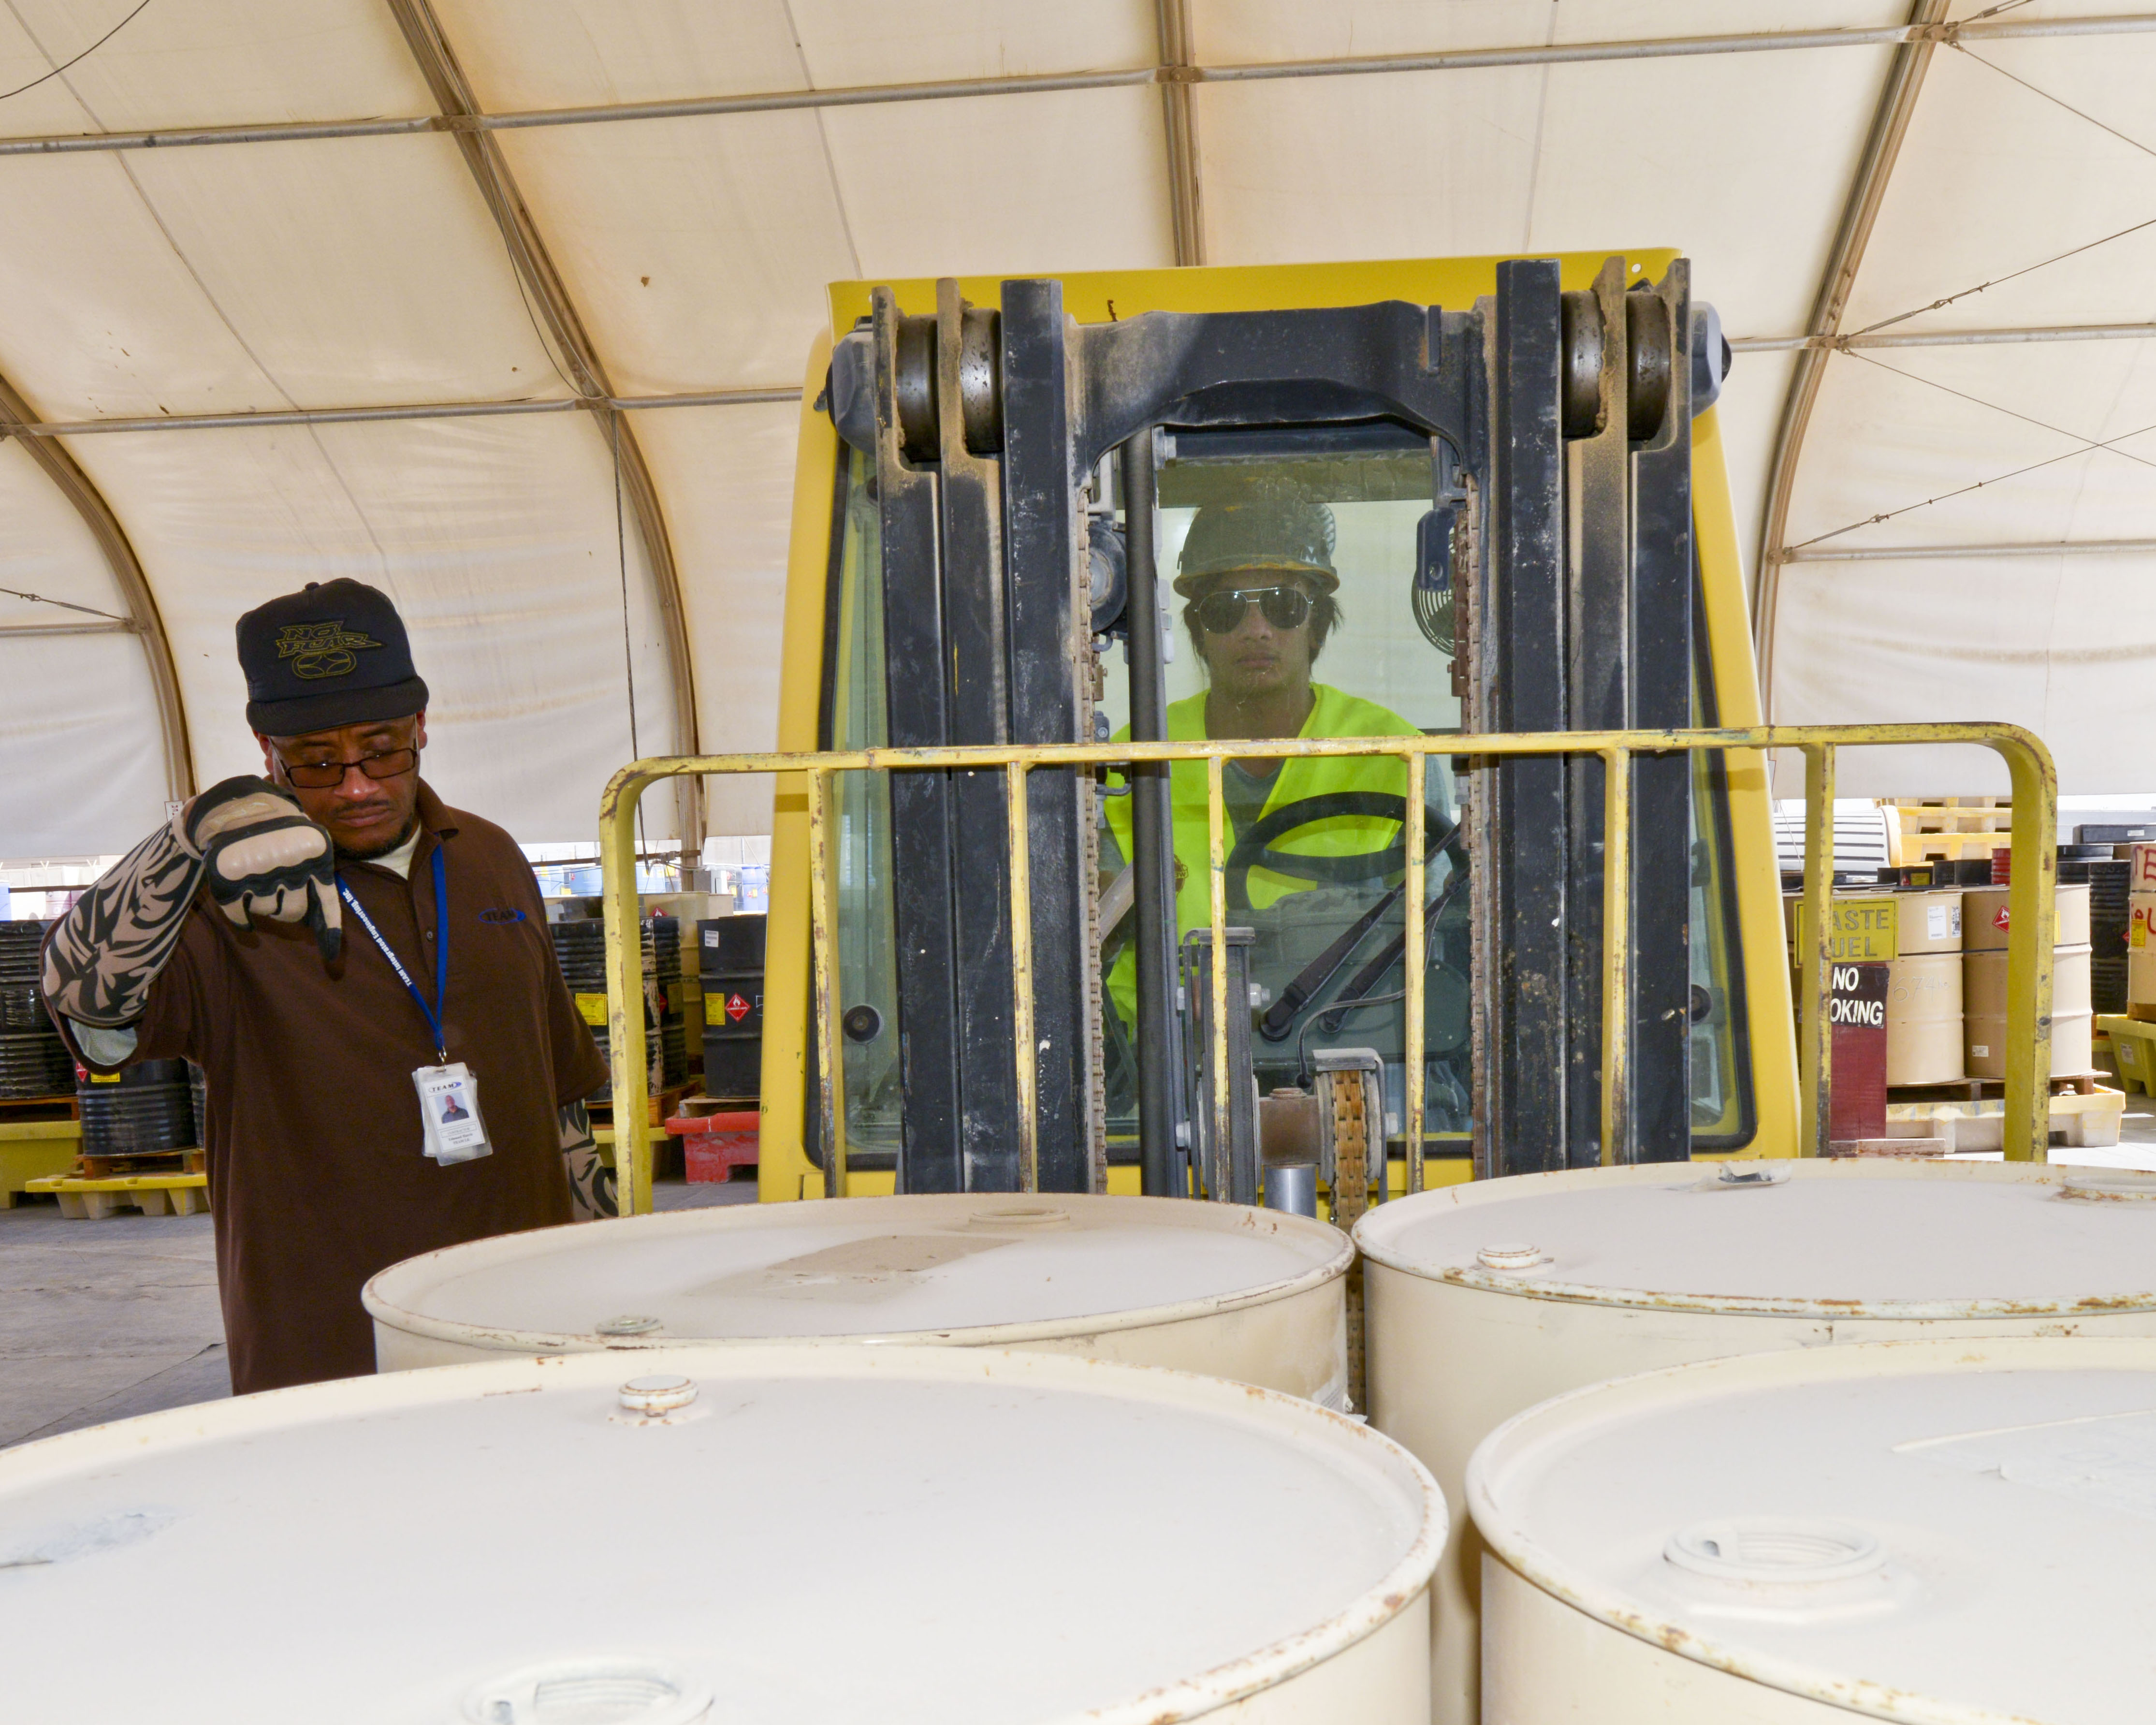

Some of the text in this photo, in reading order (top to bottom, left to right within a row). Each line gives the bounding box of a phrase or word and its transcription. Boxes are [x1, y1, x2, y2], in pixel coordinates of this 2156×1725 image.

[283, 623, 340, 640] NO
[279, 634, 371, 656] FEAR
[1832, 909, 1889, 931] ASTE
[376, 937, 402, 971] Integrated
[1831, 937, 1877, 958] UEL
[398, 969, 412, 987] TEAM
[1832, 966, 1859, 991] NO
[1830, 998, 1883, 1025] OKING
[432, 1083, 454, 1092] TEAM
